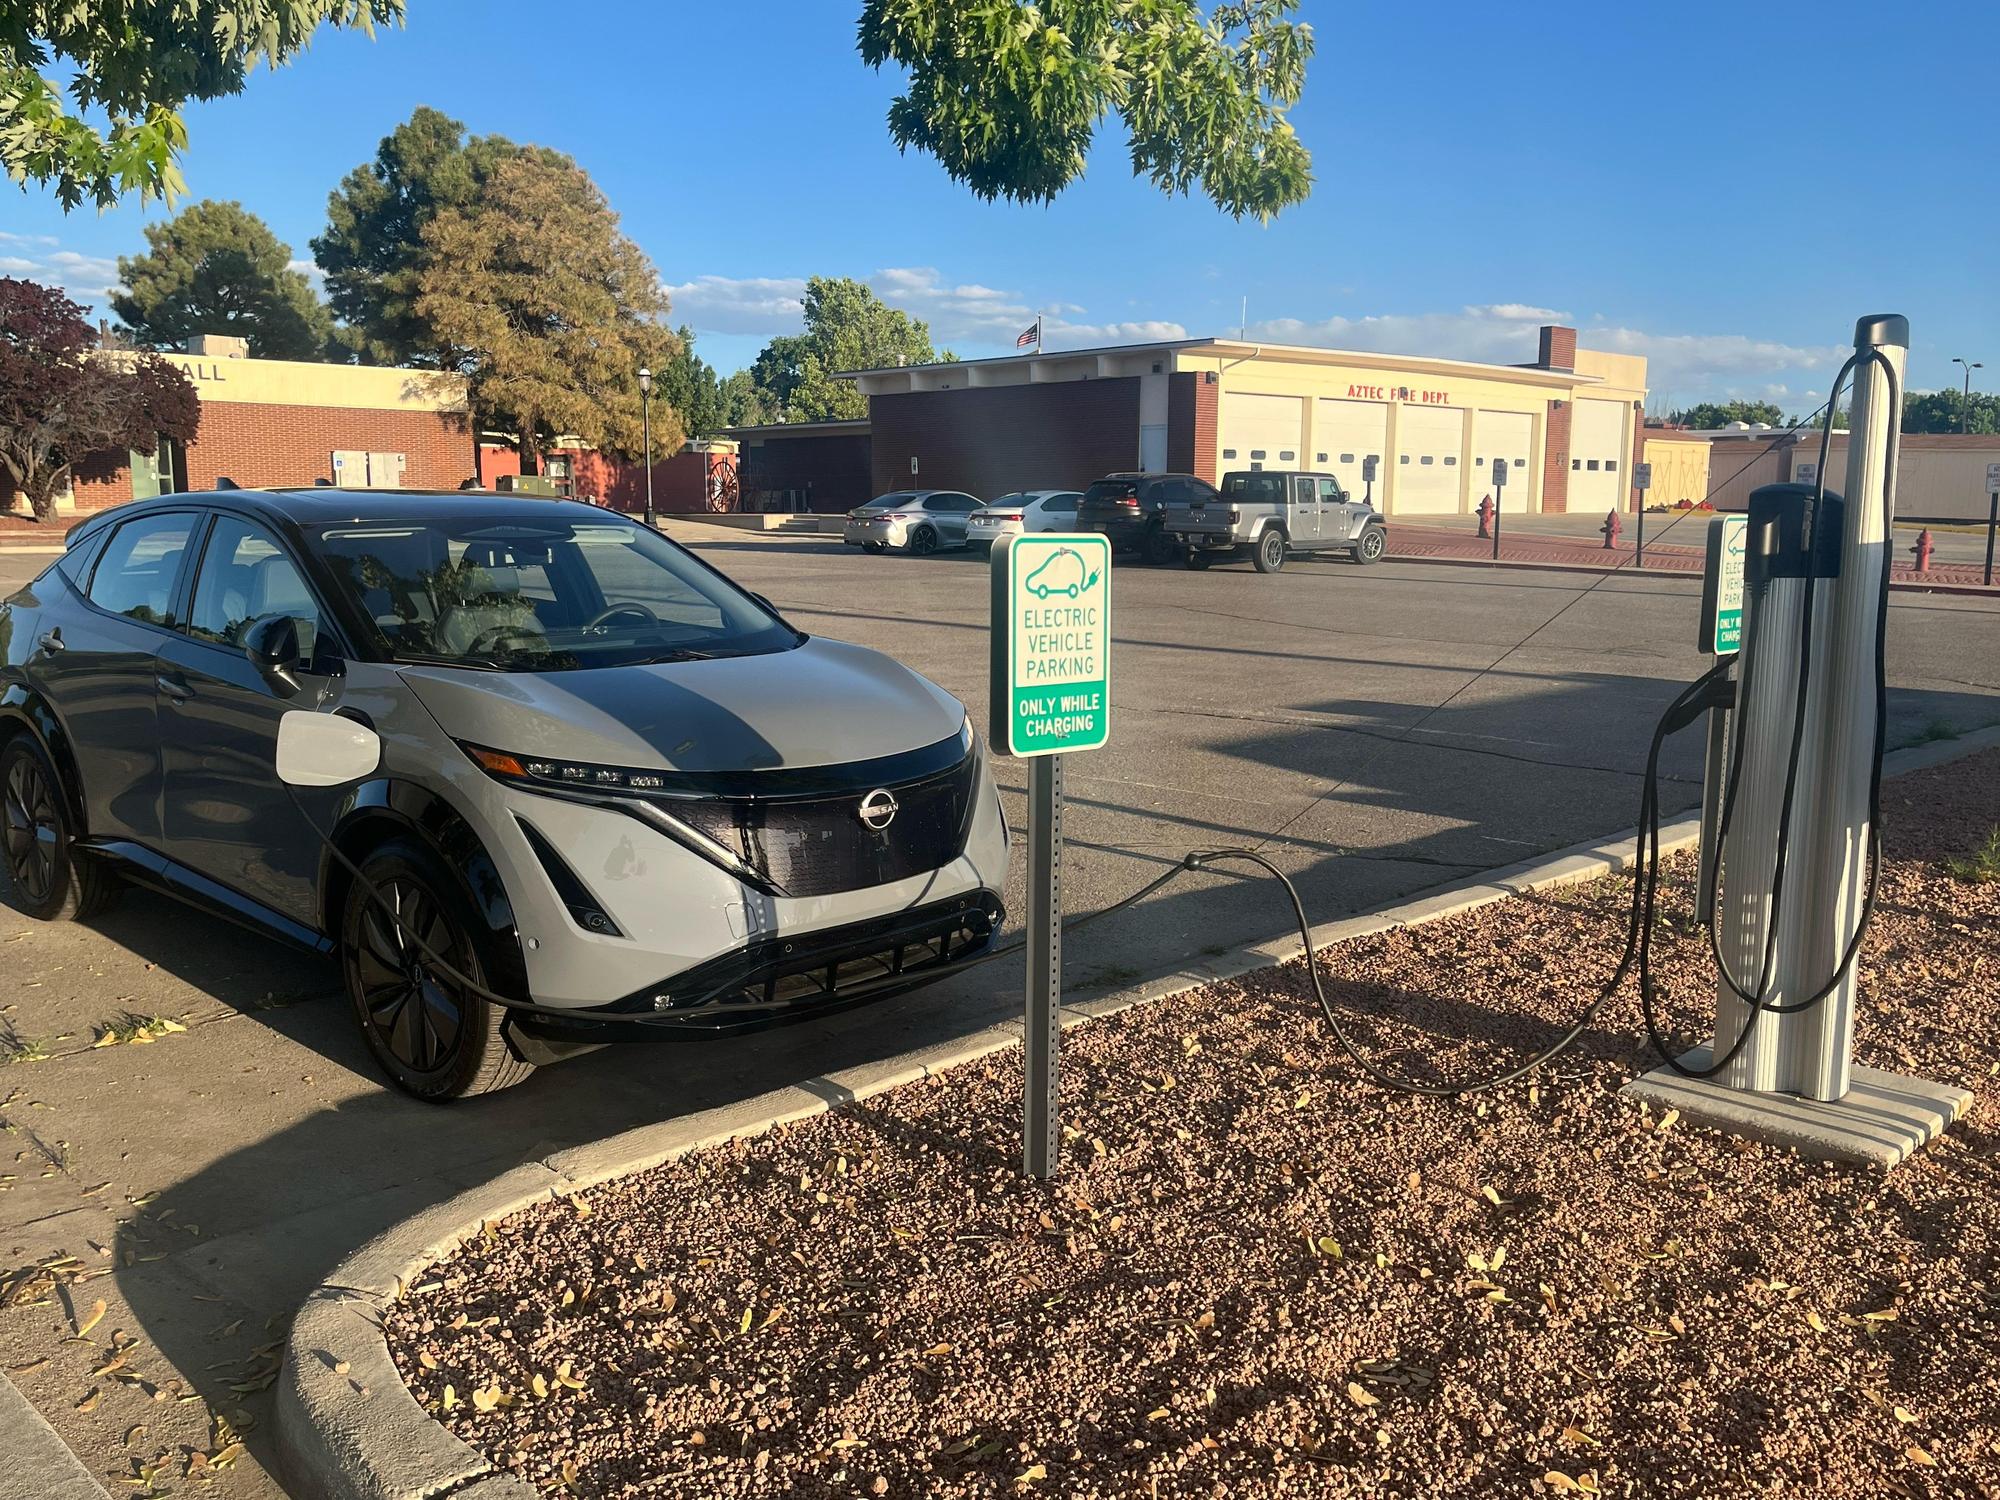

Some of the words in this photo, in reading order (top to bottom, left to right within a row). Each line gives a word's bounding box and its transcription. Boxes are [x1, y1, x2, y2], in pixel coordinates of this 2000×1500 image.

[181, 363, 226, 381] ALL
[1347, 384, 1384, 400] AZTEC
[1422, 390, 1450, 404] DEPT.
[1725, 562, 1745, 575] ELECT
[1727, 577, 1745, 590] VEHIC
[1724, 592, 1741, 606] PARK
[1024, 607, 1097, 629] ELECTRIC
[1028, 632, 1093, 654] VEHICLE
[1721, 629, 1740, 642] CHARG
[1026, 656, 1094, 679] PARKING
[1019, 697, 1056, 717] ONLY
[1060, 693, 1100, 712] WHILE
[1025, 714, 1094, 737] CHARGING
